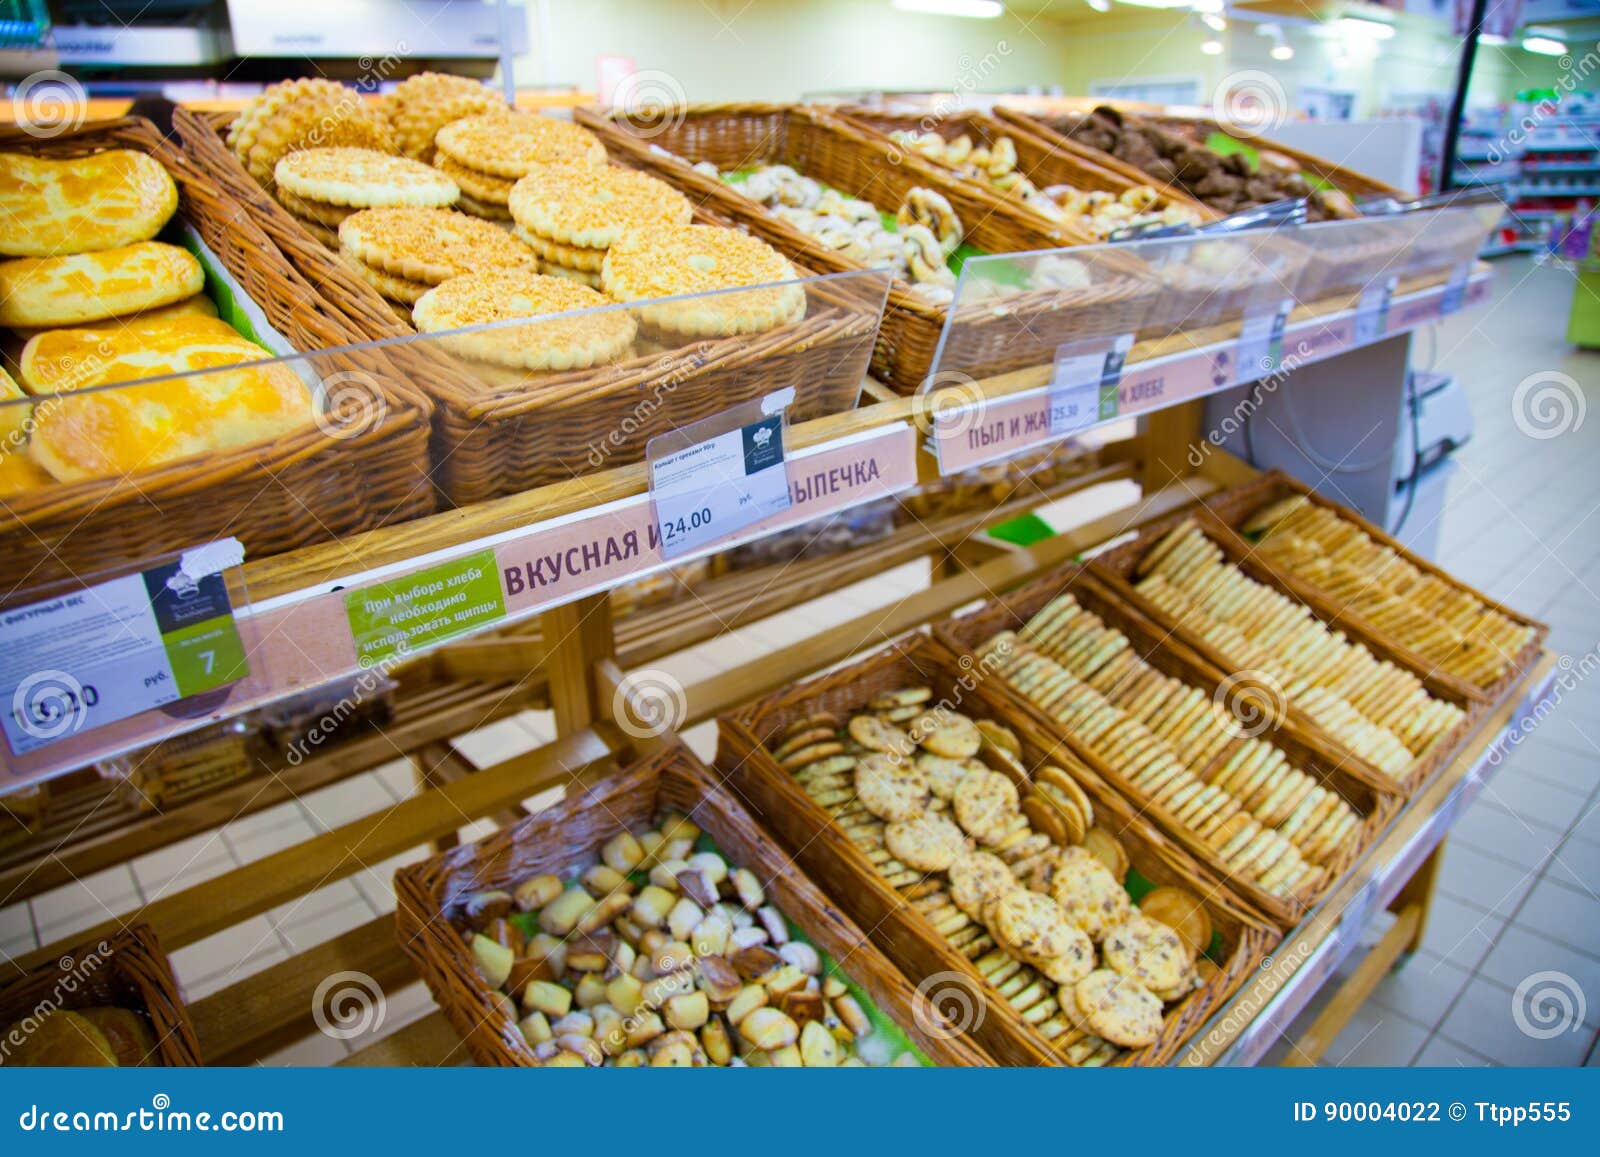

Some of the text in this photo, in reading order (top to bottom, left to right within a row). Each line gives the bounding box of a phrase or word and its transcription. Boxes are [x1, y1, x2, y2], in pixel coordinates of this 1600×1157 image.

[969, 422, 1004, 449] ПЫЛ
[1010, 418, 1020, 437] И
[504, 531, 639, 595] ВКУСНАЯ
[788, 458, 880, 506] ЫПЕЧКА
[664, 508, 711, 539] 24.00
[365, 567, 482, 613] При выборе хлеба
[390, 592, 467, 624] необходимо
[363, 600, 497, 652] использовать щипцы
[197, 651, 215, 675] 7
